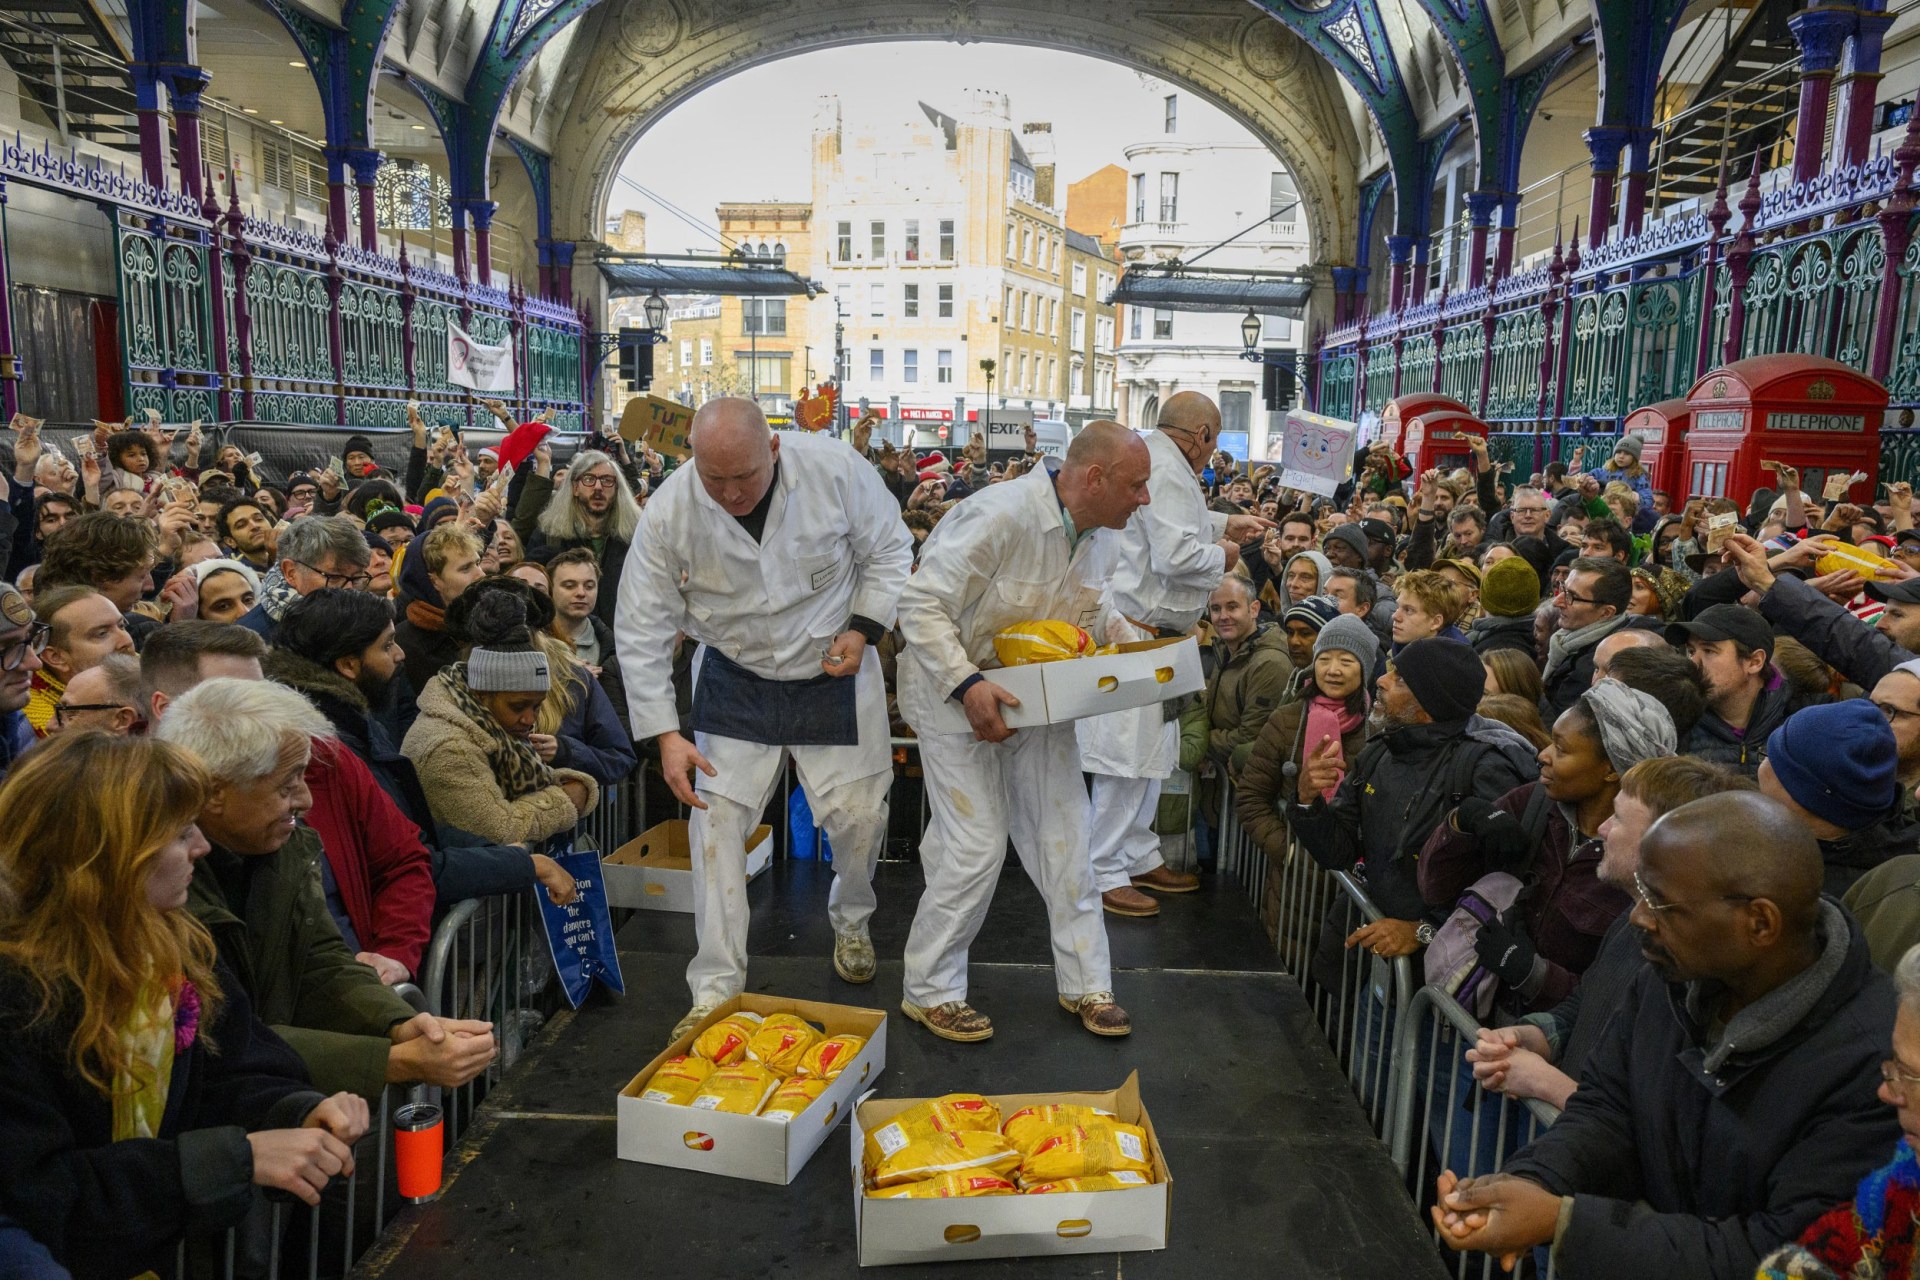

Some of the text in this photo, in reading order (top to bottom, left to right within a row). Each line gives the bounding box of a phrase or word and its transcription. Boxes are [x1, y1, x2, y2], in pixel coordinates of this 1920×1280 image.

[1699, 411, 1743, 429] TELEPHONE
[1769, 414, 1861, 431] TELEPHONE
[989, 422, 1020, 435] EXIT
[1035, 445, 1060, 454] NCEPT
[566, 906, 580, 918] the
[562, 919, 592, 934] dangers
[564, 929, 596, 949] you can't
